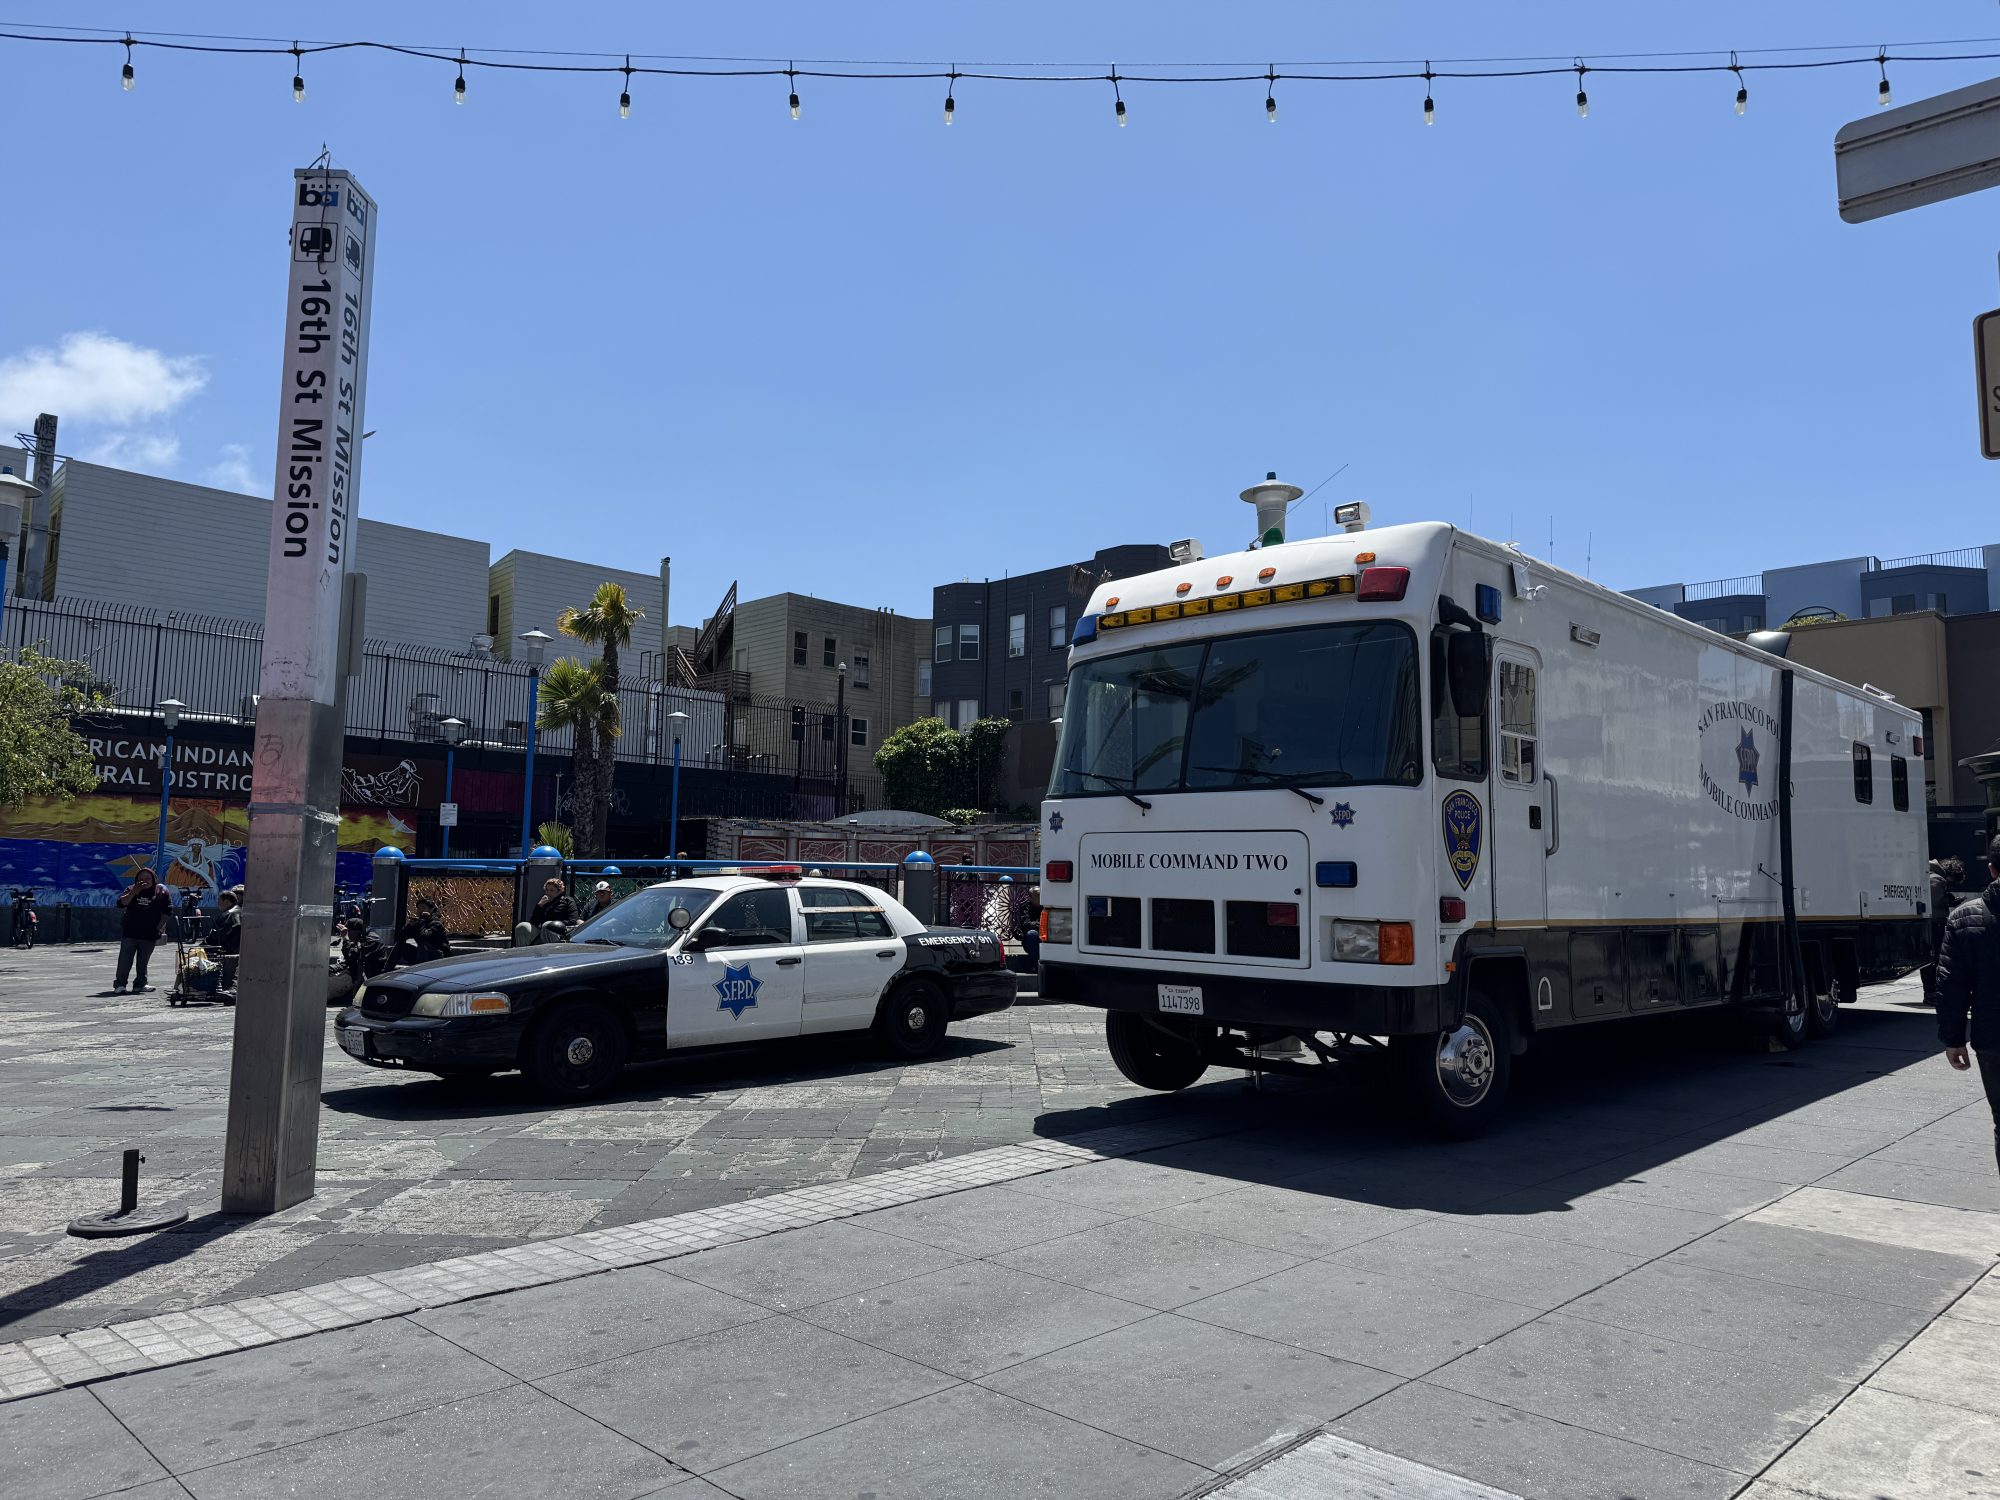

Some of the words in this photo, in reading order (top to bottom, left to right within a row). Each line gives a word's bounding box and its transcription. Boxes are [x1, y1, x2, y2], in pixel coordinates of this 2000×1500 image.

[298, 279, 332, 353] 16th
[341, 293, 359, 366] 16th
[294, 370, 326, 403] St
[338, 377, 353, 416] St
[283, 419, 323, 557] Mission
[328, 425, 351, 565] Mission
[1697, 706, 1714, 738] SAN
[1715, 701, 1764, 727] FRANCISCO
[176, 744, 255, 768] INDIAN
[1698, 762, 1733, 814] MOBILE
[1734, 799, 1780, 821] COMMAND
[1454, 810, 1471, 820] POLICE
[1090, 853, 1146, 869] MOBILE
[1149, 853, 1239, 870] COMMAND
[1242, 854, 1289, 871] TWO
[1883, 884, 1912, 899] EMERGENCY
[1914, 885, 1922, 899] 911
[918, 935, 975, 946] EMERGENCY
[978, 935, 993, 944] 911
[670, 954, 694, 966] 139
[1161, 994, 1200, 1011] 1147398
